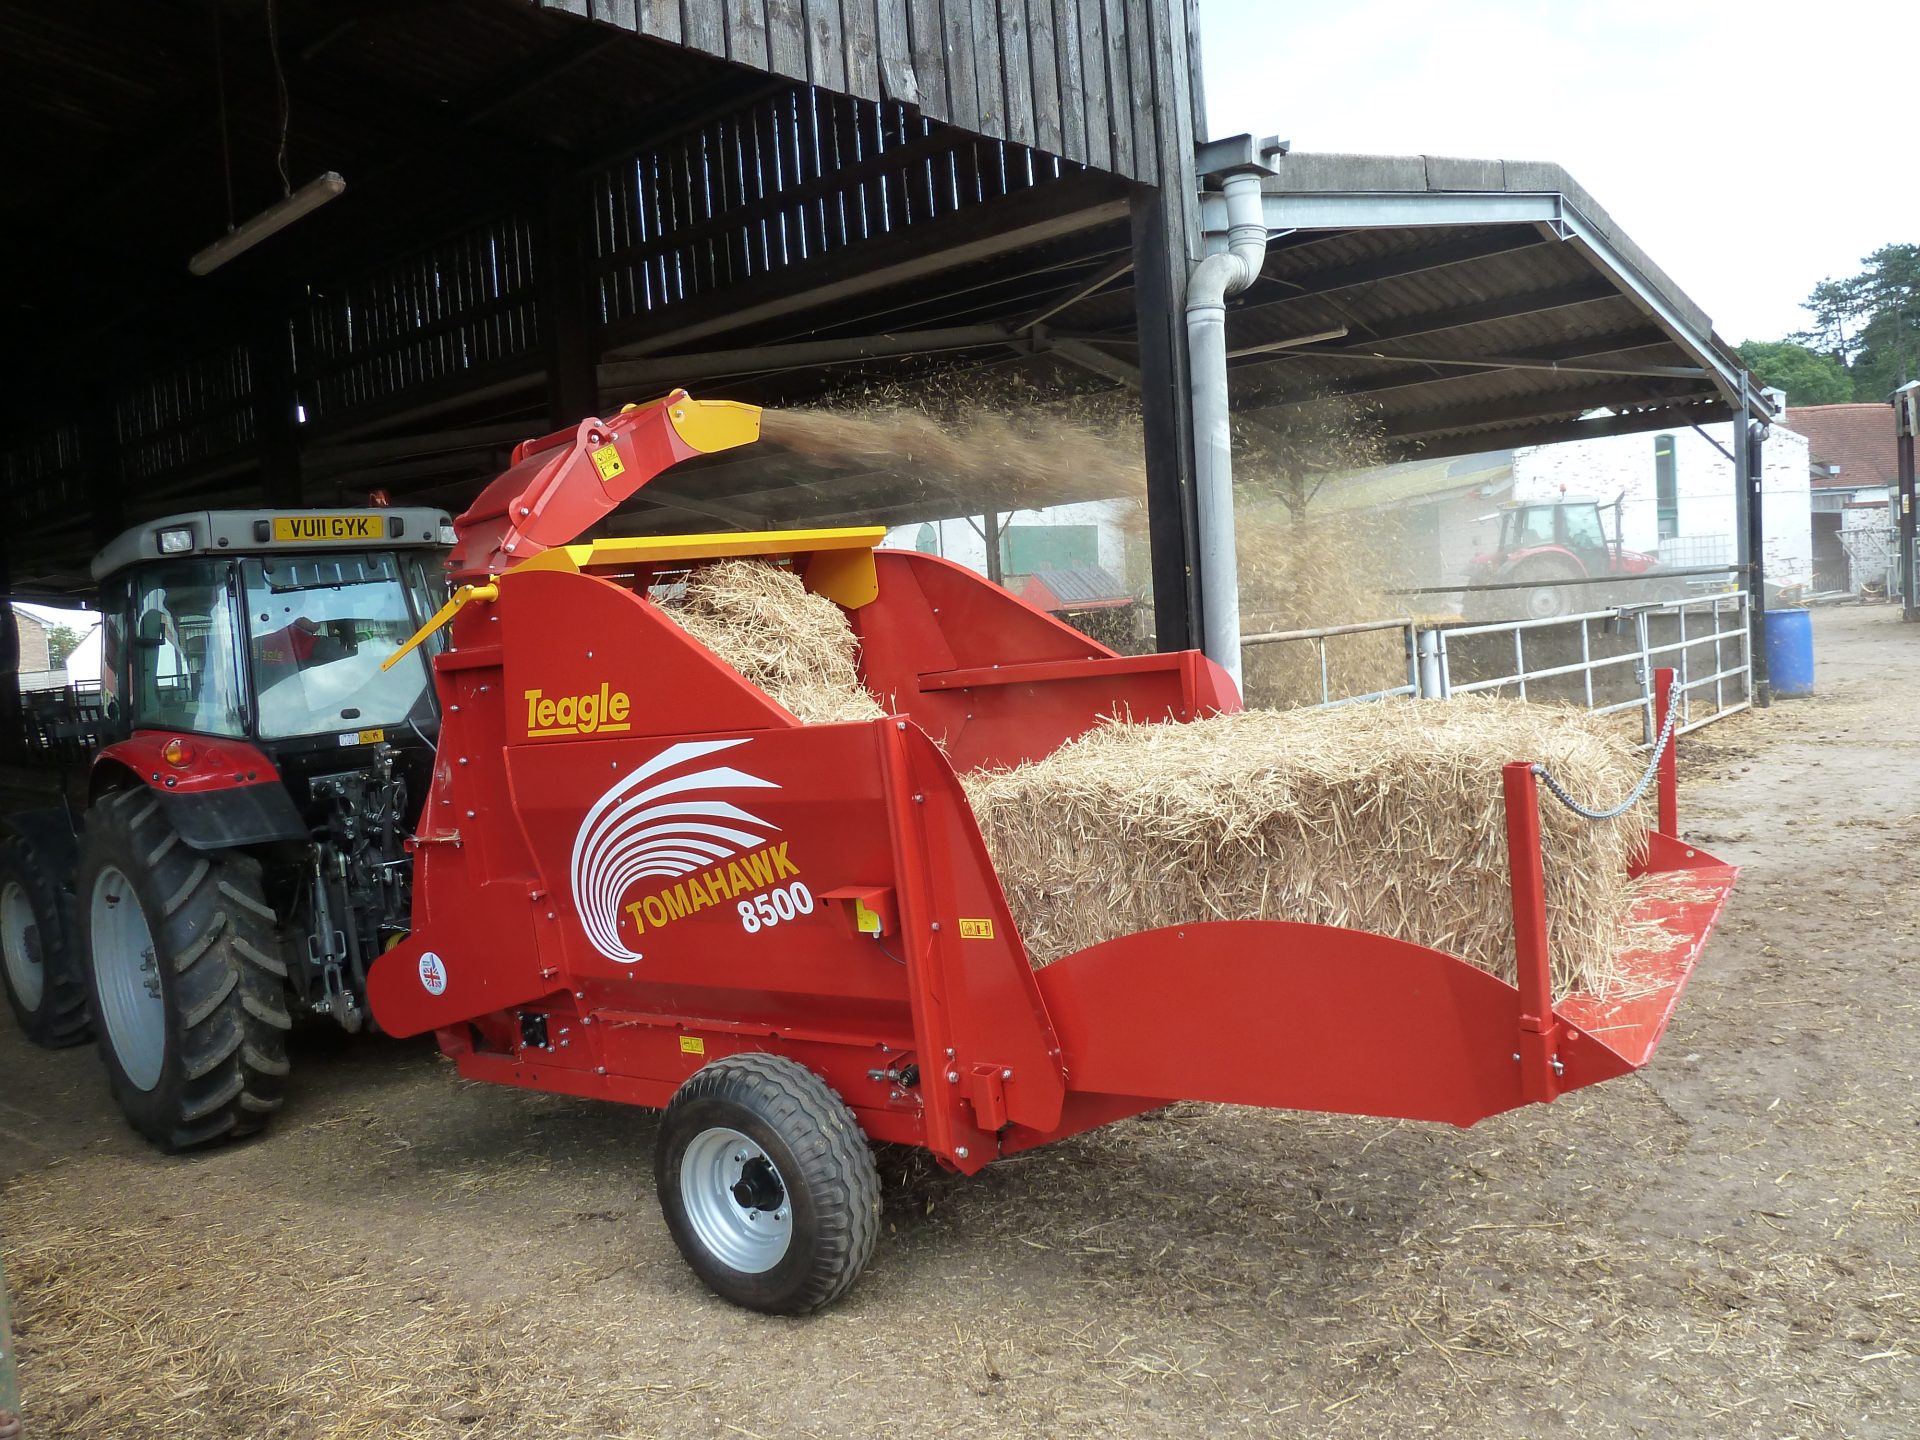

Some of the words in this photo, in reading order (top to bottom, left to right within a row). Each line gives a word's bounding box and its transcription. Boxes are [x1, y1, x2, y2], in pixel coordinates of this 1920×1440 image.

[331, 518, 369, 537] GYK
[524, 682, 631, 737] Teagle
[625, 841, 801, 935] TOMAHAWK
[737, 881, 814, 934] 8500
